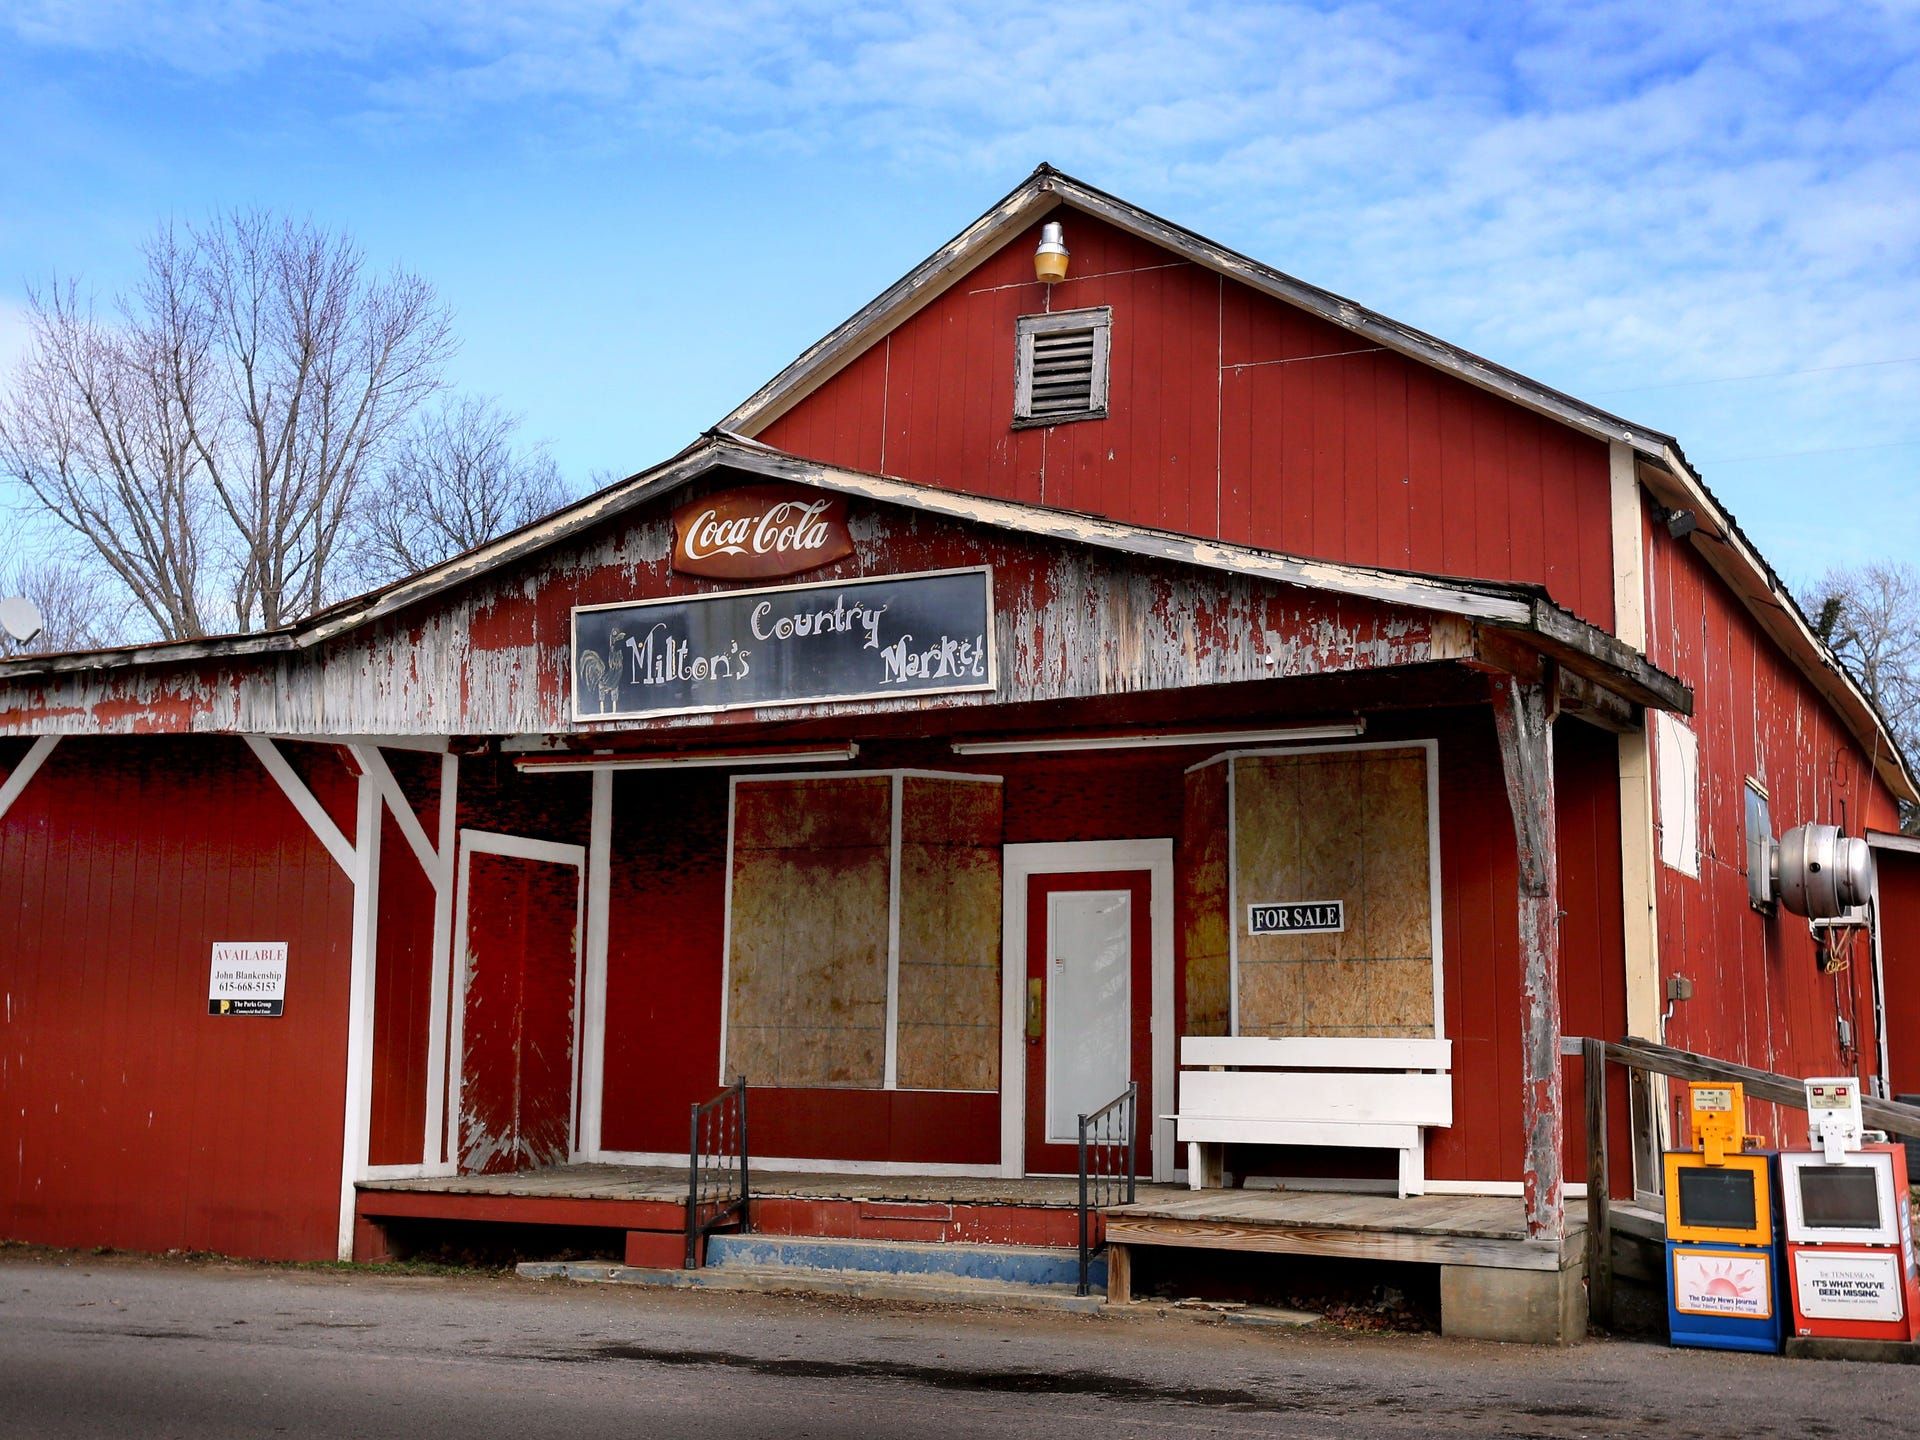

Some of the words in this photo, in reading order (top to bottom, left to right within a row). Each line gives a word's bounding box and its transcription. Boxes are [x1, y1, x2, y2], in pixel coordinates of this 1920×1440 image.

[685, 499, 833, 560] Coca-Cola
[751, 594, 887, 649] Country
[626, 623, 751, 685] Milton's
[879, 634, 984, 685] Market
[1255, 909, 1290, 929] FOR
[1293, 907, 1338, 927] SALE
[215, 949, 284, 961] AVAILABLE
[215, 971, 233, 980] John
[235, 971, 282, 982] Blankenship
[219, 982, 276, 992] 615-668-5153
[257, 1001, 272, 1009] Group
[1832, 1271, 1875, 1279] TENNESSEAN
[1812, 1280, 1828, 1288] IT'S
[1829, 1280, 1853, 1289] WHAT
[1854, 1281, 1885, 1290] YOU'VE
[1819, 1288, 1841, 1297] BEEN
[1843, 1289, 1880, 1298] MISSING.
[1701, 1295, 1716, 1304] Daily
[1735, 1298, 1758, 1306] Journal
